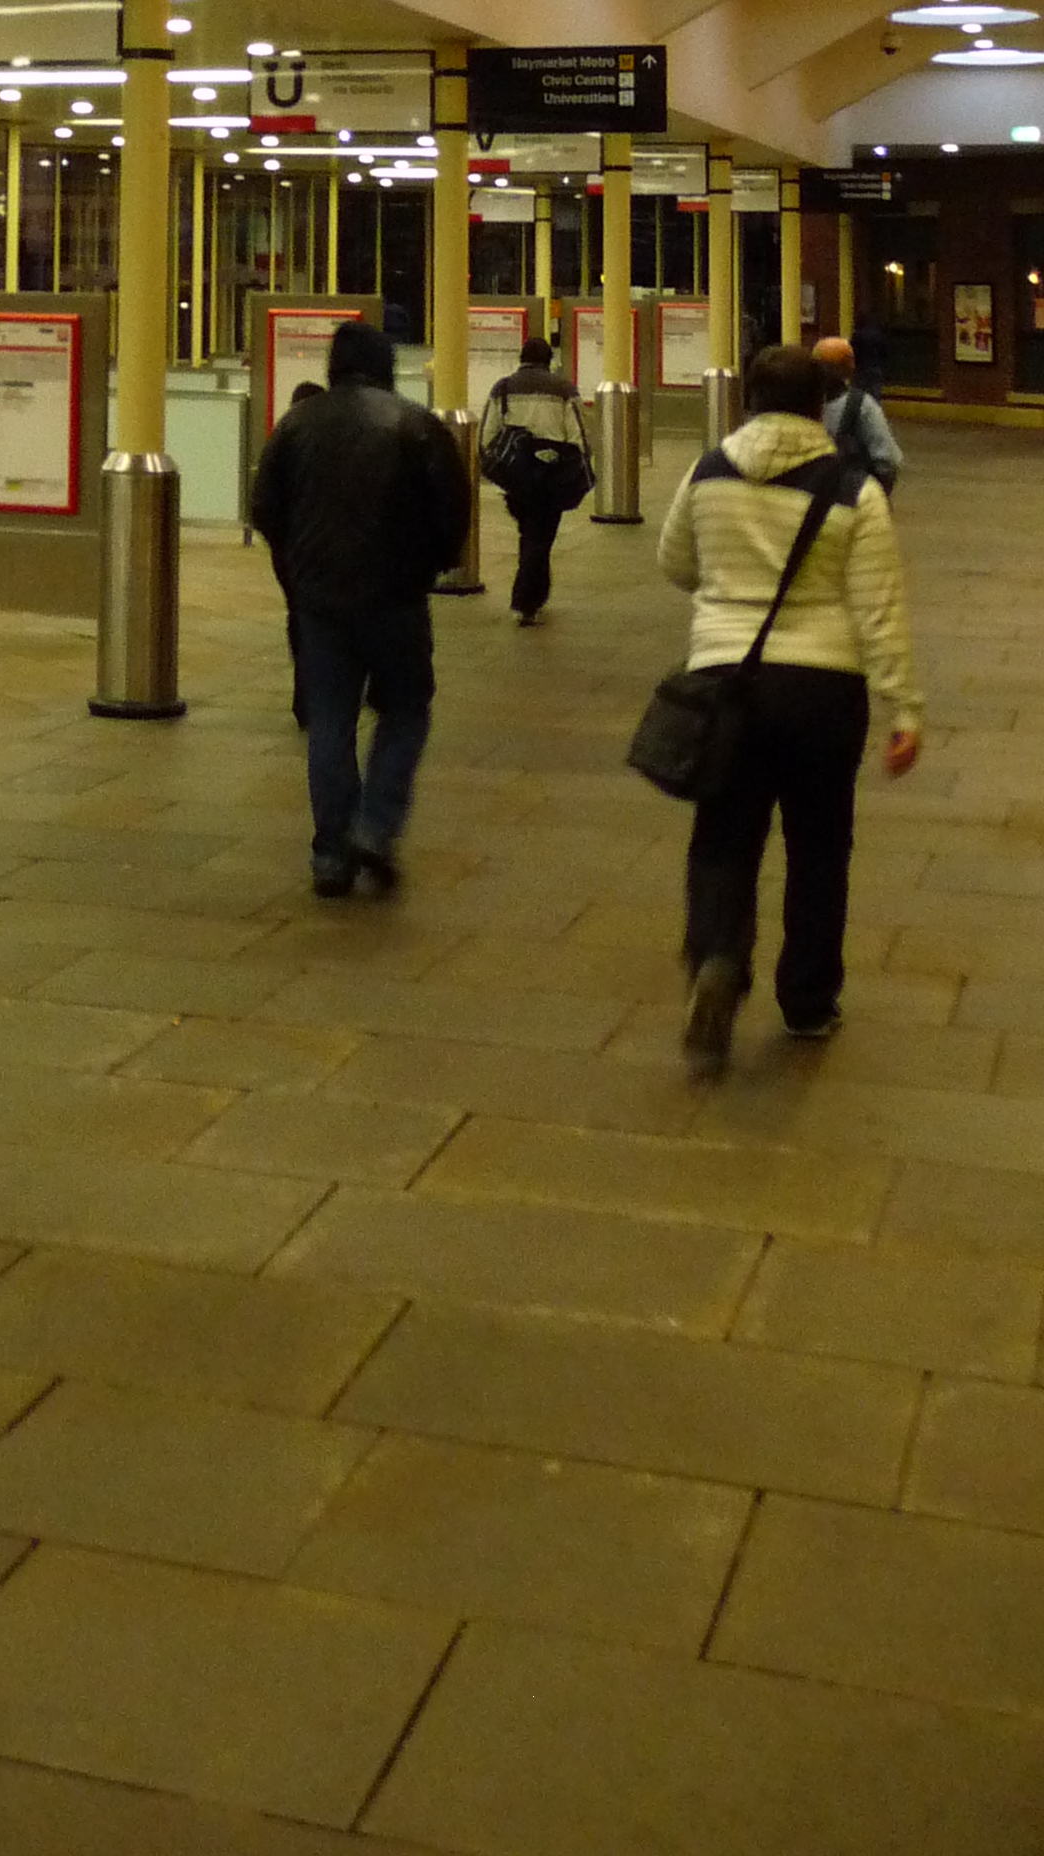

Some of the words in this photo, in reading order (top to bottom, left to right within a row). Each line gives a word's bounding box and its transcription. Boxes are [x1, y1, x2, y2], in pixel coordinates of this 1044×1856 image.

[512, 56, 578, 70] Haymarket
[580, 55, 615, 69] Metro
[262, 60, 307, 109] U
[542, 74, 573, 87] Civic
[575, 73, 616, 87] Centre
[544, 91, 616, 106] Universities
